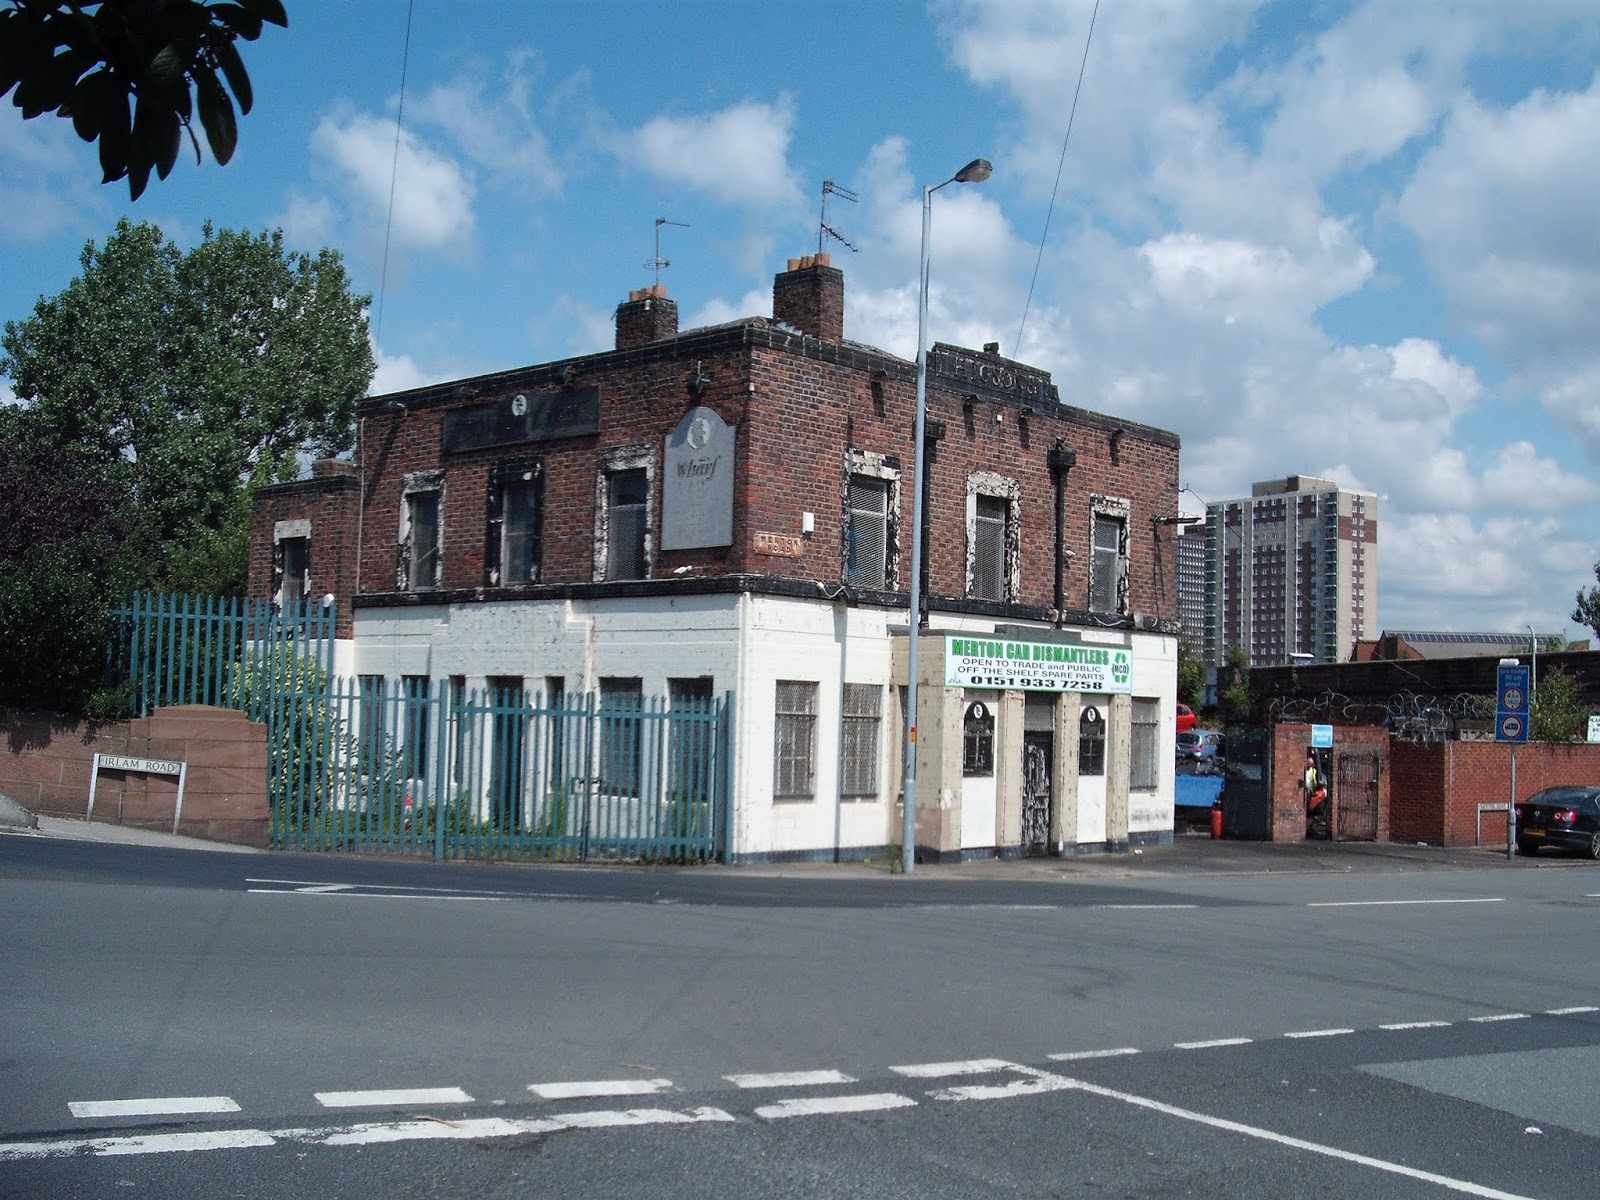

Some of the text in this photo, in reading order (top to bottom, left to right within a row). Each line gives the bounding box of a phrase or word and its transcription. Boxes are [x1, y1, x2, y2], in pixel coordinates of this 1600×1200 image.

[760, 535, 798, 546] MERTON
[768, 544, 791, 553] ROAD
[951, 638, 1110, 666] MERTON CAR DISMANTLERS
[957, 665, 1105, 681] OFF THE SHELF SPARE PARTS
[962, 657, 1102, 674] OPEN TO TRADE and PUBLIC
[970, 675, 1015, 687] 0151
[1019, 677, 1056, 689] 933
[1061, 680, 1103, 690] 7258
[104, 757, 175, 772] IRLAM ROAD
